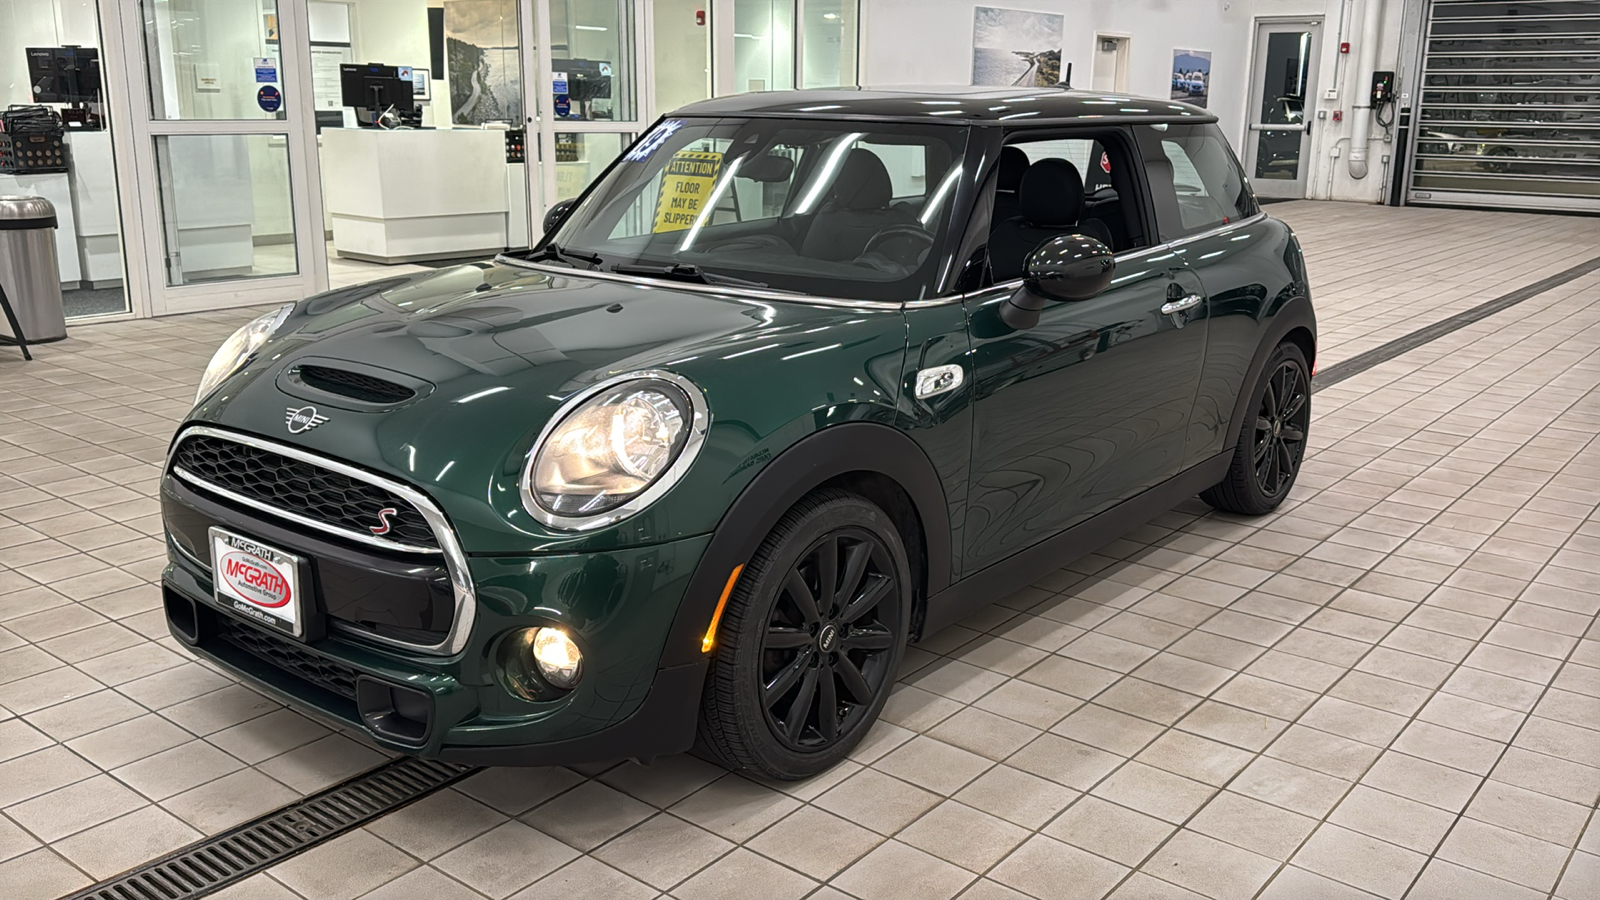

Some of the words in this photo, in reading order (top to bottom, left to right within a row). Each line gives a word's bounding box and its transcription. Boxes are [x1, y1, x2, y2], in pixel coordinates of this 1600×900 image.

[670, 161, 714, 175] ATTENTION
[675, 181, 700, 194] FLOOR
[670, 197, 687, 209] MAY
[687, 198, 699, 210] BE
[293, 414, 310, 424] MINI
[369, 508, 397, 535] S
[238, 580, 262, 595] Automotive
[263, 589, 277, 601] Group
[233, 601, 276, 625] GoMcGrath.com
[823, 629, 835, 649] MINI
